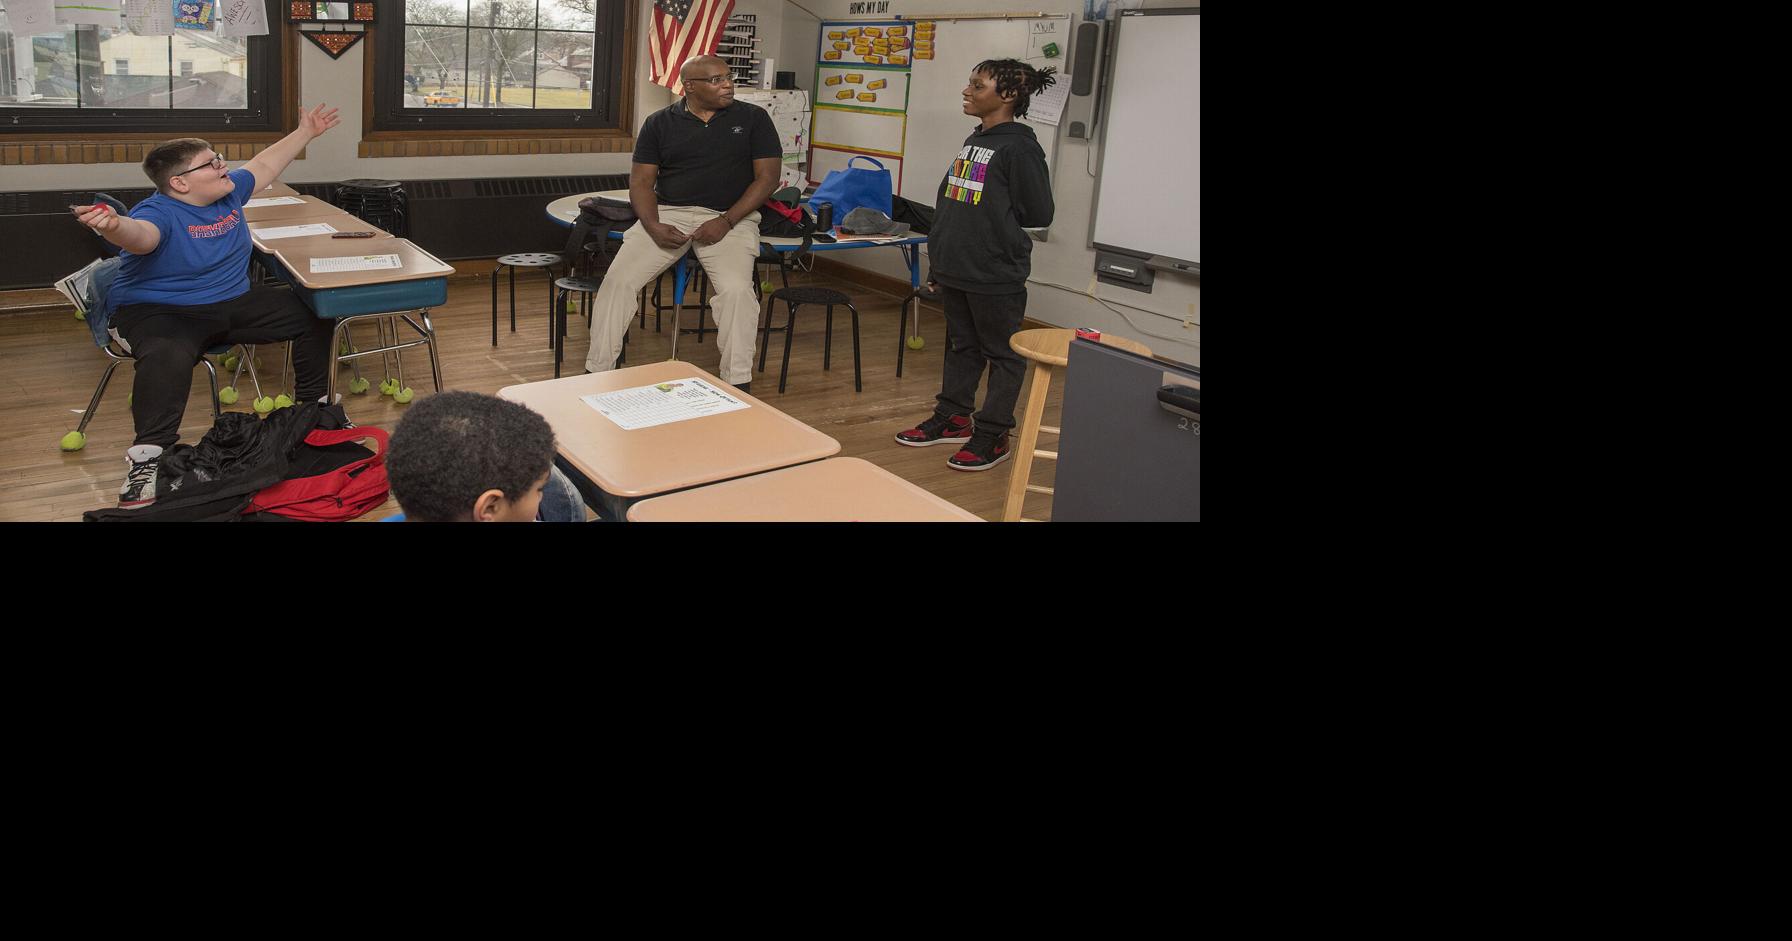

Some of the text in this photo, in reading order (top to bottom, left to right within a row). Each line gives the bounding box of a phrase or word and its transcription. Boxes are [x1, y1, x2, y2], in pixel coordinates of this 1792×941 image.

[849, 1, 889, 14] HOWS MY DAY
[970, 145, 995, 164] THE
